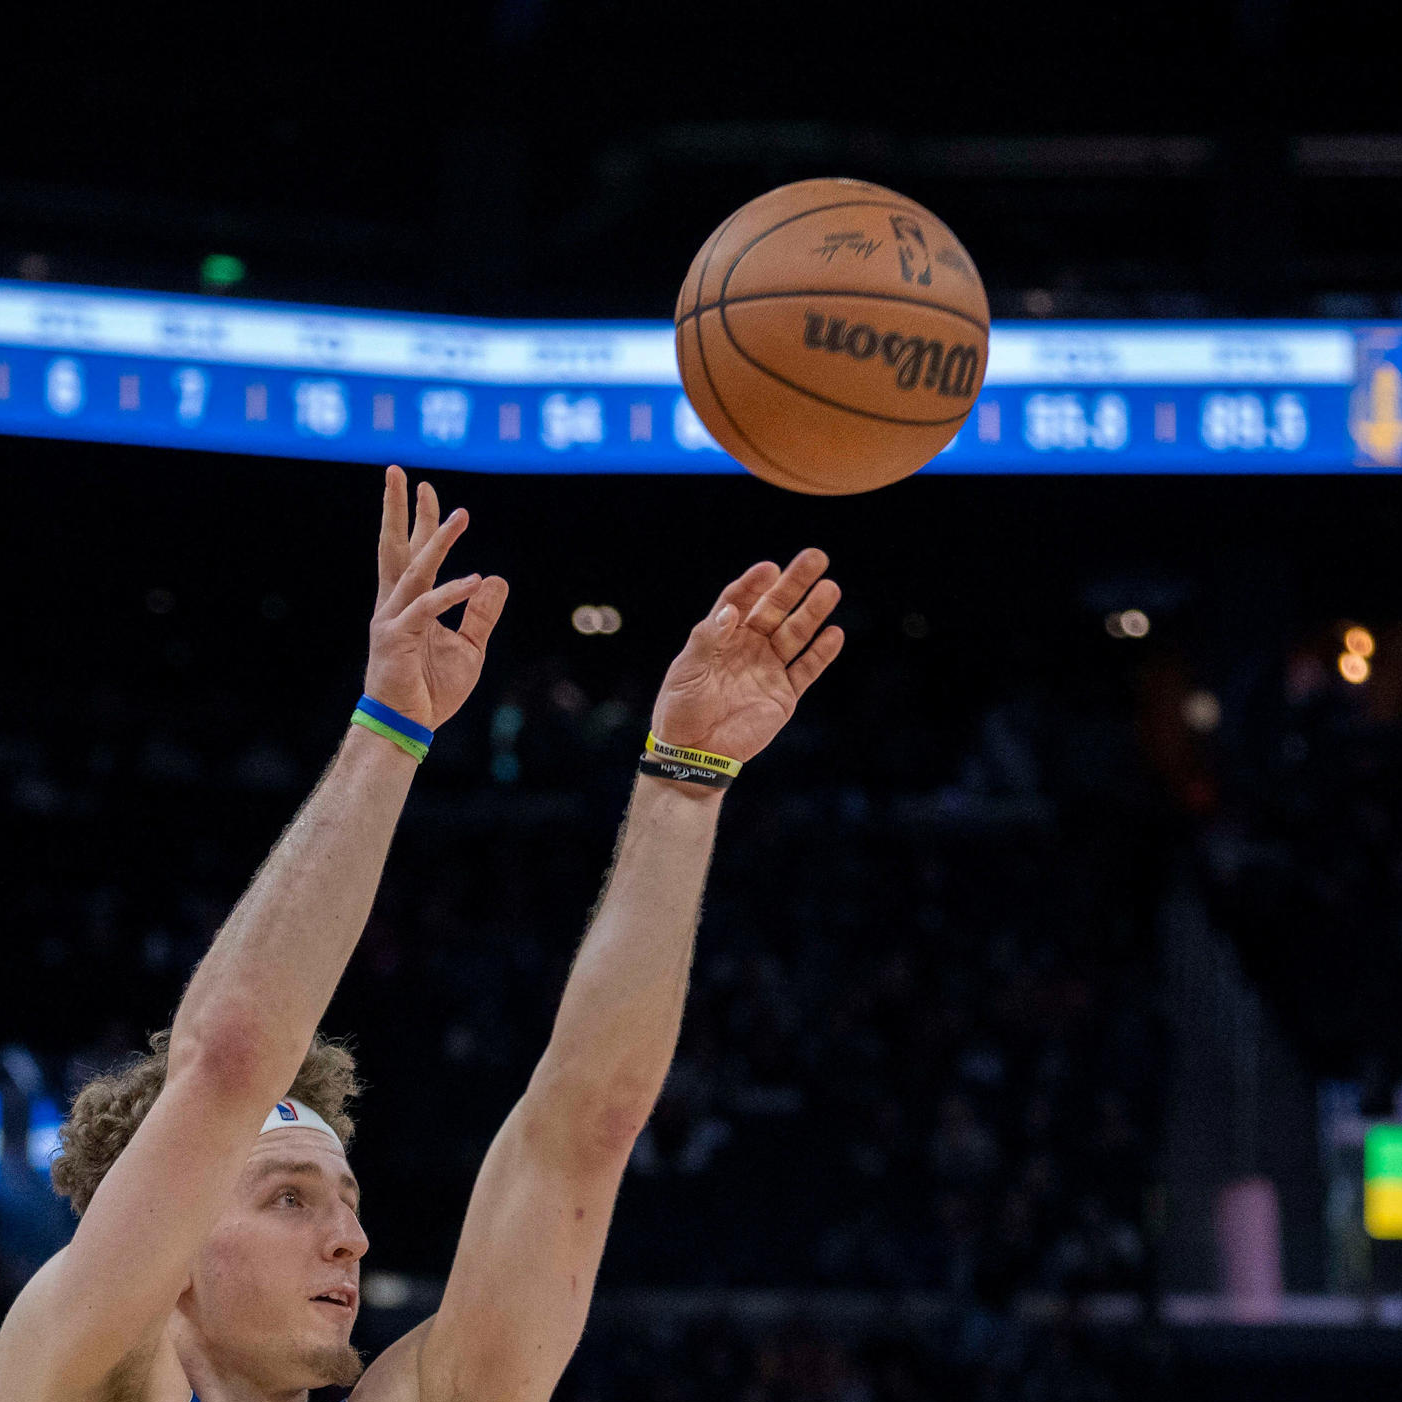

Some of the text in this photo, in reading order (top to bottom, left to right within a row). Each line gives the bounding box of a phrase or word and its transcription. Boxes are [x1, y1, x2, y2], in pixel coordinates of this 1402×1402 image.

[803, 309, 978, 398] Wilson
[654, 743, 731, 770] BASKETBALL FAMILY
[690, 767, 716, 780] ACTIVE
